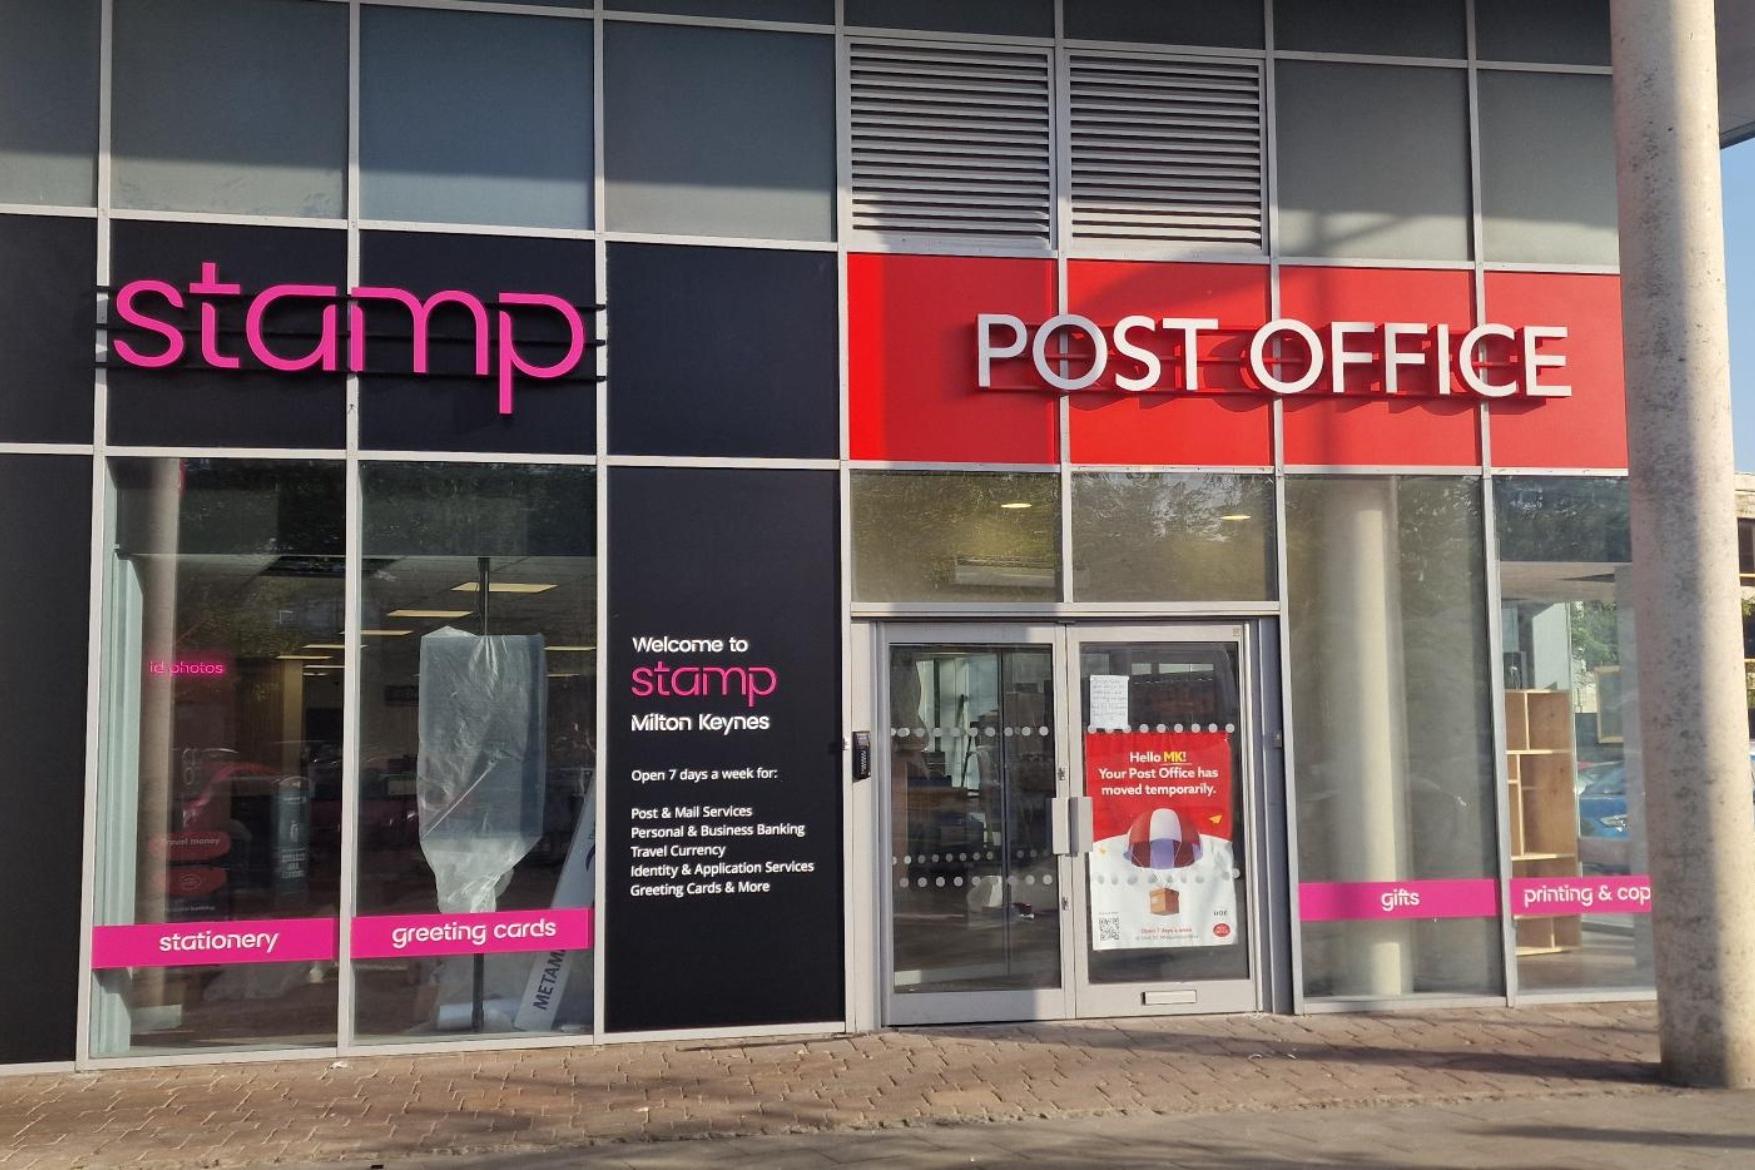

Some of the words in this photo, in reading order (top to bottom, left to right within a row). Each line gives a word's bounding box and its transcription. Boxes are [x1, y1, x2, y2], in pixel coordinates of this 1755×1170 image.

[113, 262, 585, 415] stamp
[976, 313, 1219, 392] POST
[1248, 317, 1572, 398] OFFICE
[632, 636, 724, 653] Welcome
[729, 636, 749, 652] to
[150, 660, 164, 674] id
[631, 661, 777, 707] stamp
[631, 713, 692, 732] Milton
[699, 713, 770, 735] Keynes
[1129, 751, 1161, 763] Hello
[1163, 751, 1187, 763] MK!
[631, 769, 665, 784] Open
[669, 769, 677, 781] 7
[679, 768, 708, 783] days
[711, 771, 719, 780] a
[721, 767, 754, 780] week
[756, 767, 778, 780] for:
[1099, 768, 1129, 779] Your
[1129, 767, 1156, 779] Post
[1158, 766, 1195, 778] Office
[1197, 767, 1219, 778] has
[1101, 784, 1143, 796] moved
[1145, 783, 1217, 798] temporarily.
[631, 807, 658, 819] Post
[661, 807, 672, 819] &
[674, 806, 699, 818] Mail
[702, 805, 753, 818] Services
[631, 825, 684, 839] Personal
[687, 826, 698, 837] &
[700, 824, 754, 837] Business
[757, 823, 806, 838] Banking
[630, 845, 667, 858] Travel
[670, 844, 726, 858] Currency
[630, 865, 678, 879] Identity
[681, 864, 692, 876] &
[694, 862, 762, 877] Application
[765, 861, 815, 874] Services
[630, 884, 684, 898] Greeting
[686, 882, 722, 895] Cards
[725, 882, 735, 893] &
[737, 881, 771, 893] More
[1524, 885, 1594, 908] printing
[1598, 884, 1614, 901] &
[1380, 888, 1420, 912] gifts
[159, 930, 280, 953] stationery
[391, 922, 487, 949] greeting
[493, 918, 557, 939] cards
[532, 949, 566, 1010] METAM
